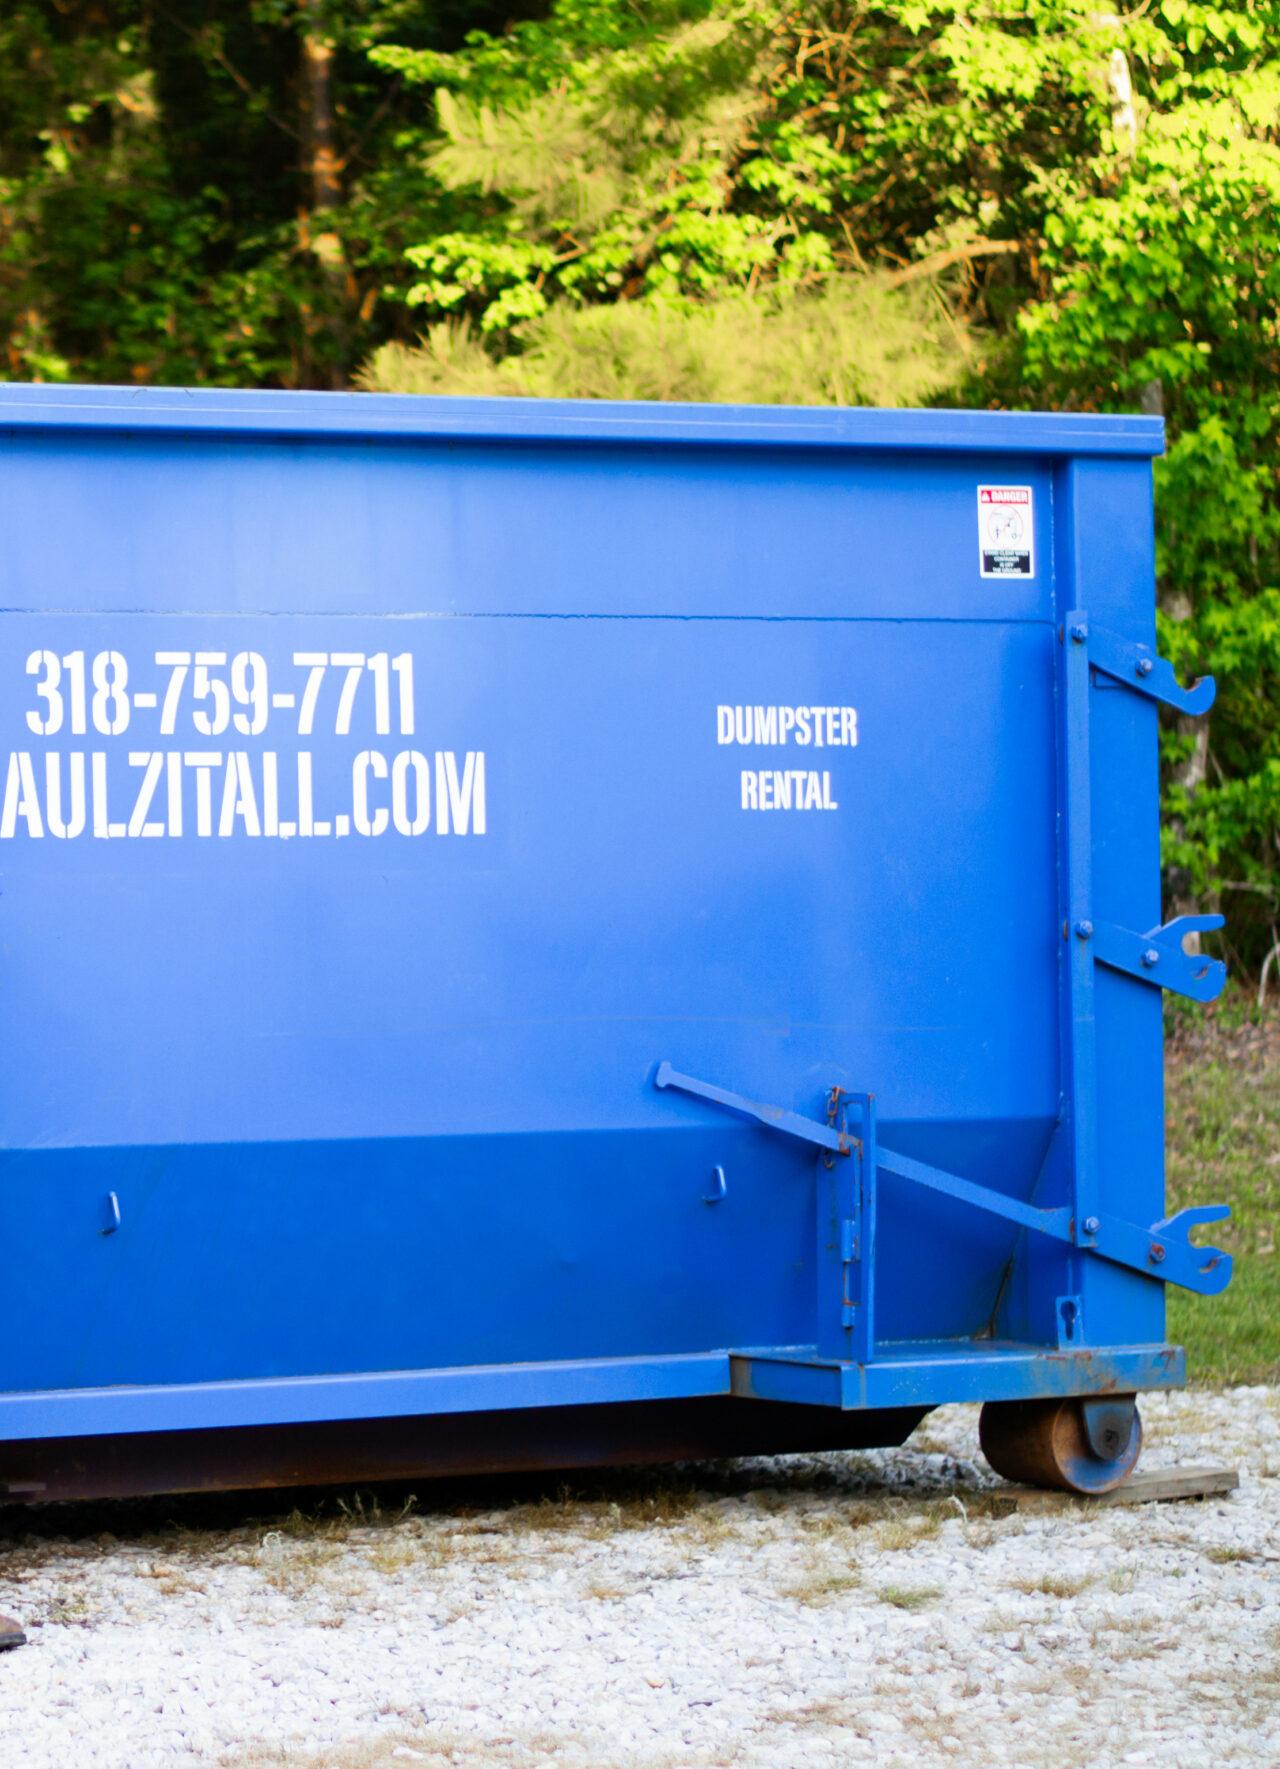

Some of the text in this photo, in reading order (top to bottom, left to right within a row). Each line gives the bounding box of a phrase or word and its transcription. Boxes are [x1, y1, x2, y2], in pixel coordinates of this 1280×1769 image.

[26, 650, 415, 736] 318-759-7711
[717, 704, 858, 747] DUMPSTER
[740, 770, 839, 811] RENTAL
